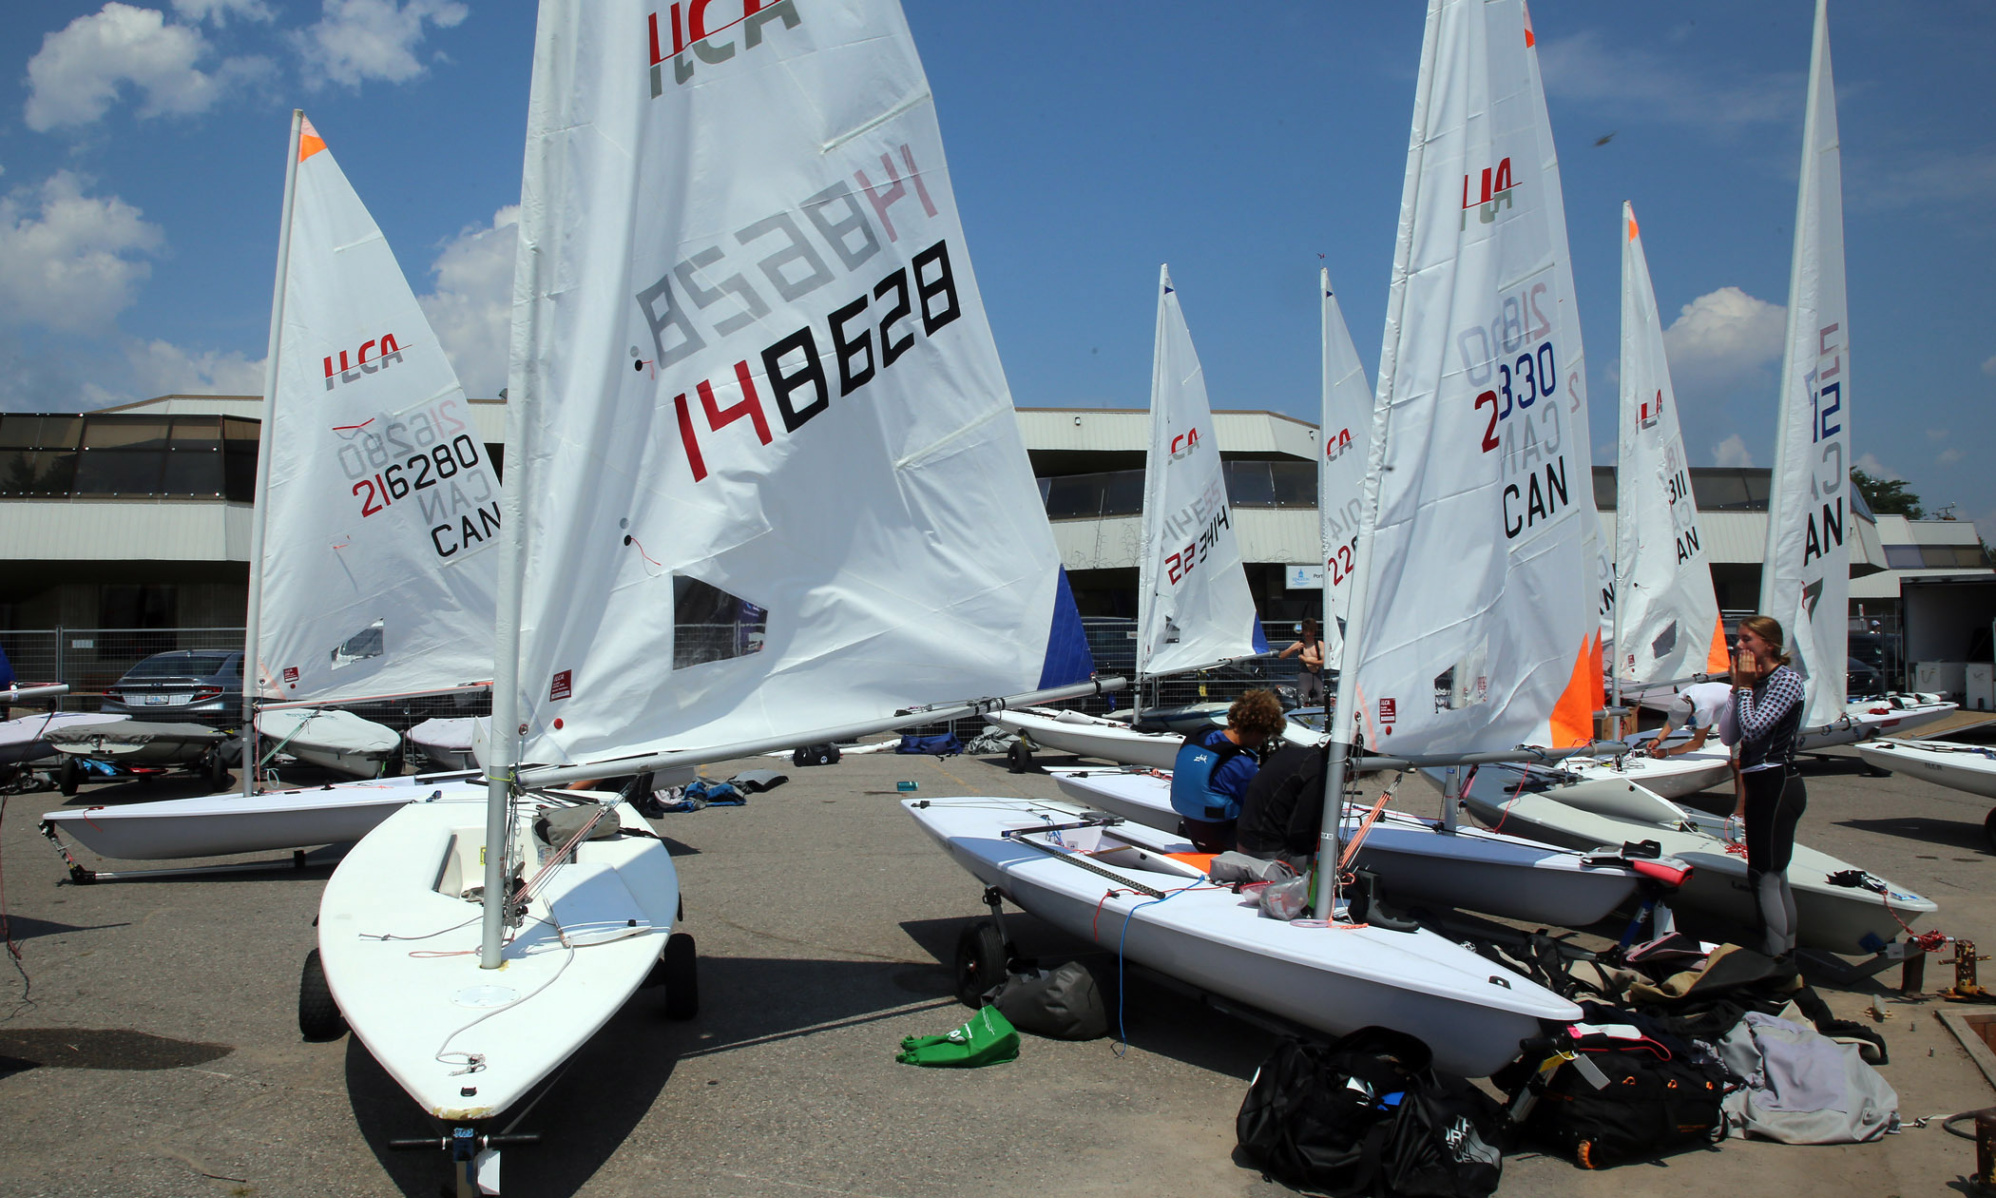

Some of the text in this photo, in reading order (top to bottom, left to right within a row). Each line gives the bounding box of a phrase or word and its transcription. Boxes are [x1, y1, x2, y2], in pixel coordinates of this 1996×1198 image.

[323, 333, 404, 391] ILCA
[674, 239, 961, 484] 148628
[352, 434, 479, 518] 216280
[1503, 455, 1568, 539] CAN
[431, 501, 501, 557] CAN
[1165, 505, 1229, 586] 223414
[1676, 526, 1700, 565] AN
[1804, 497, 1842, 568] AN
